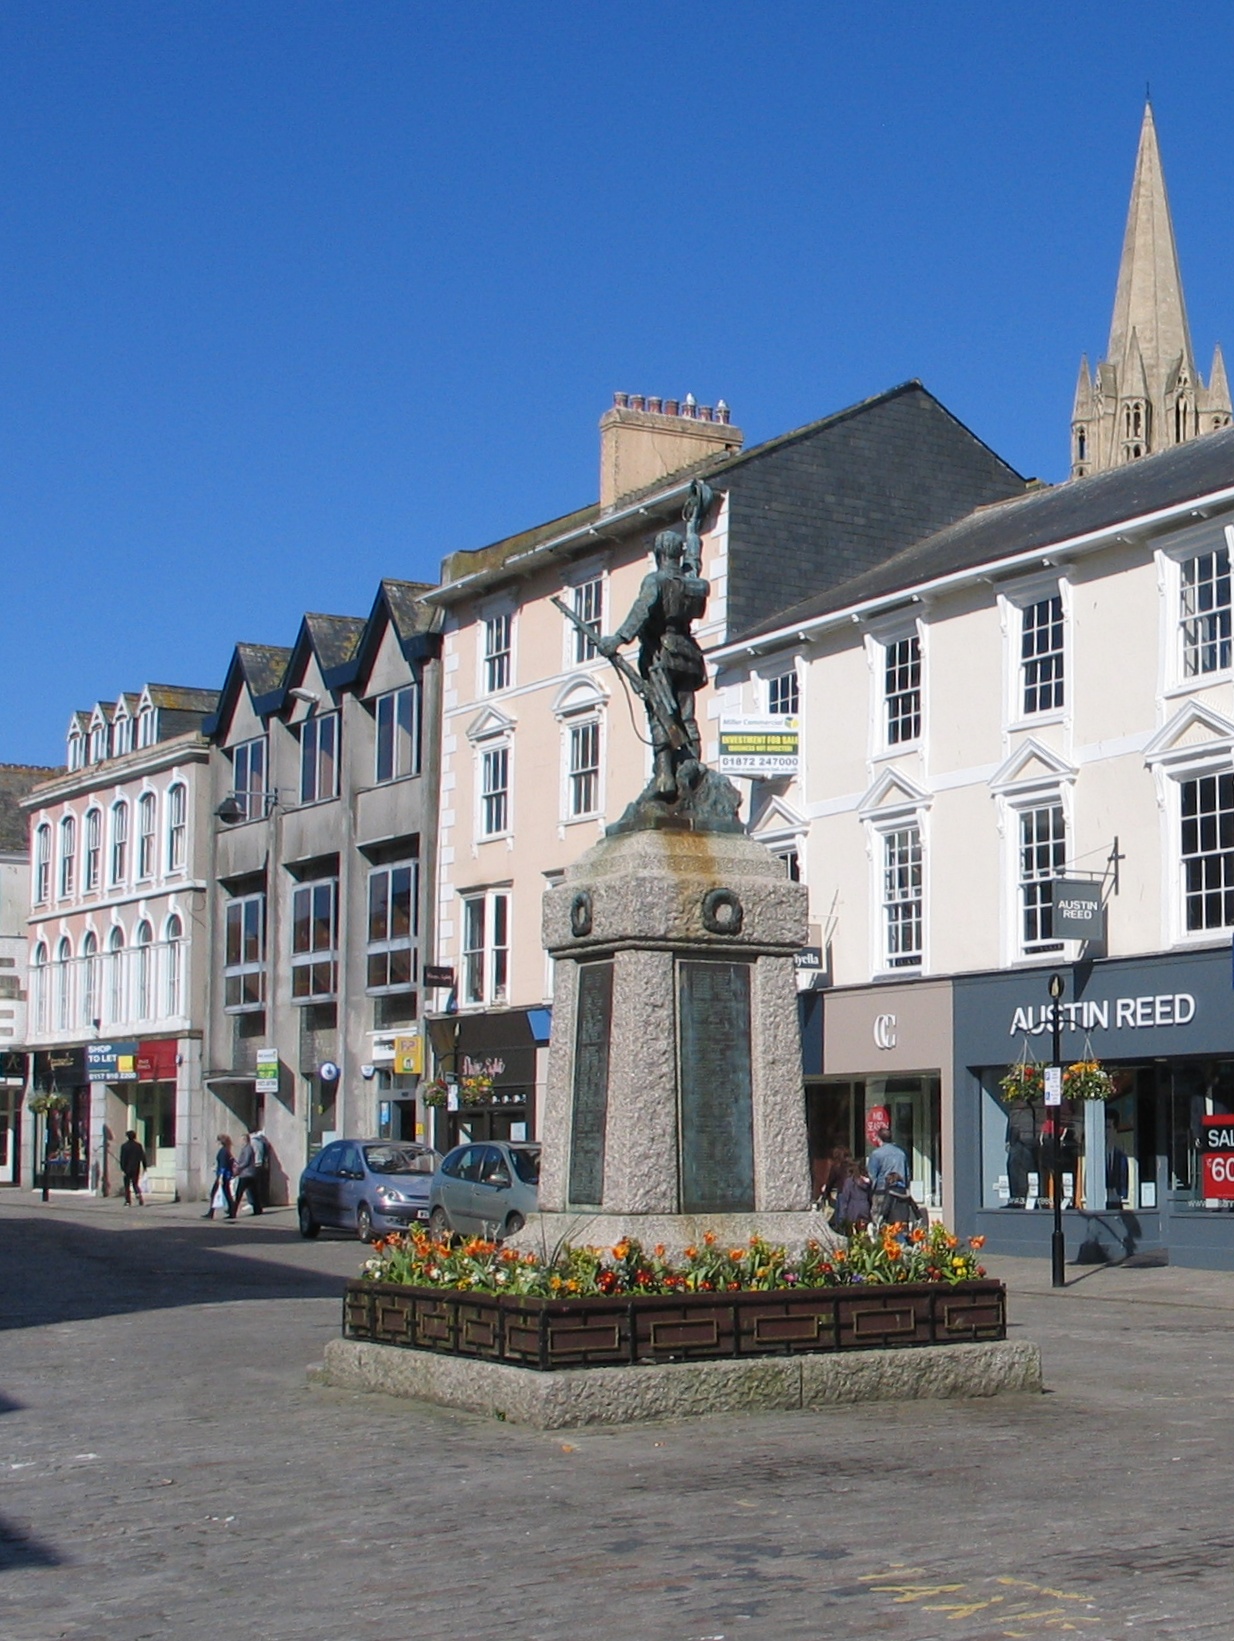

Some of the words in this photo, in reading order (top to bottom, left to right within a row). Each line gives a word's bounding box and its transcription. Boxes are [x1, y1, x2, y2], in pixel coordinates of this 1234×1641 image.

[722, 757, 755, 766] 01872
[759, 757, 798, 766] 247000
[1058, 900, 1098, 911] AUSTIN
[1063, 910, 1092, 920] REED
[1010, 1000, 1109, 1037] AUSTIN
[1116, 993, 1197, 1029] REED
[88, 1045, 112, 1053] SHOP
[88, 1055, 100, 1063] TO
[101, 1054, 117, 1063] LET
